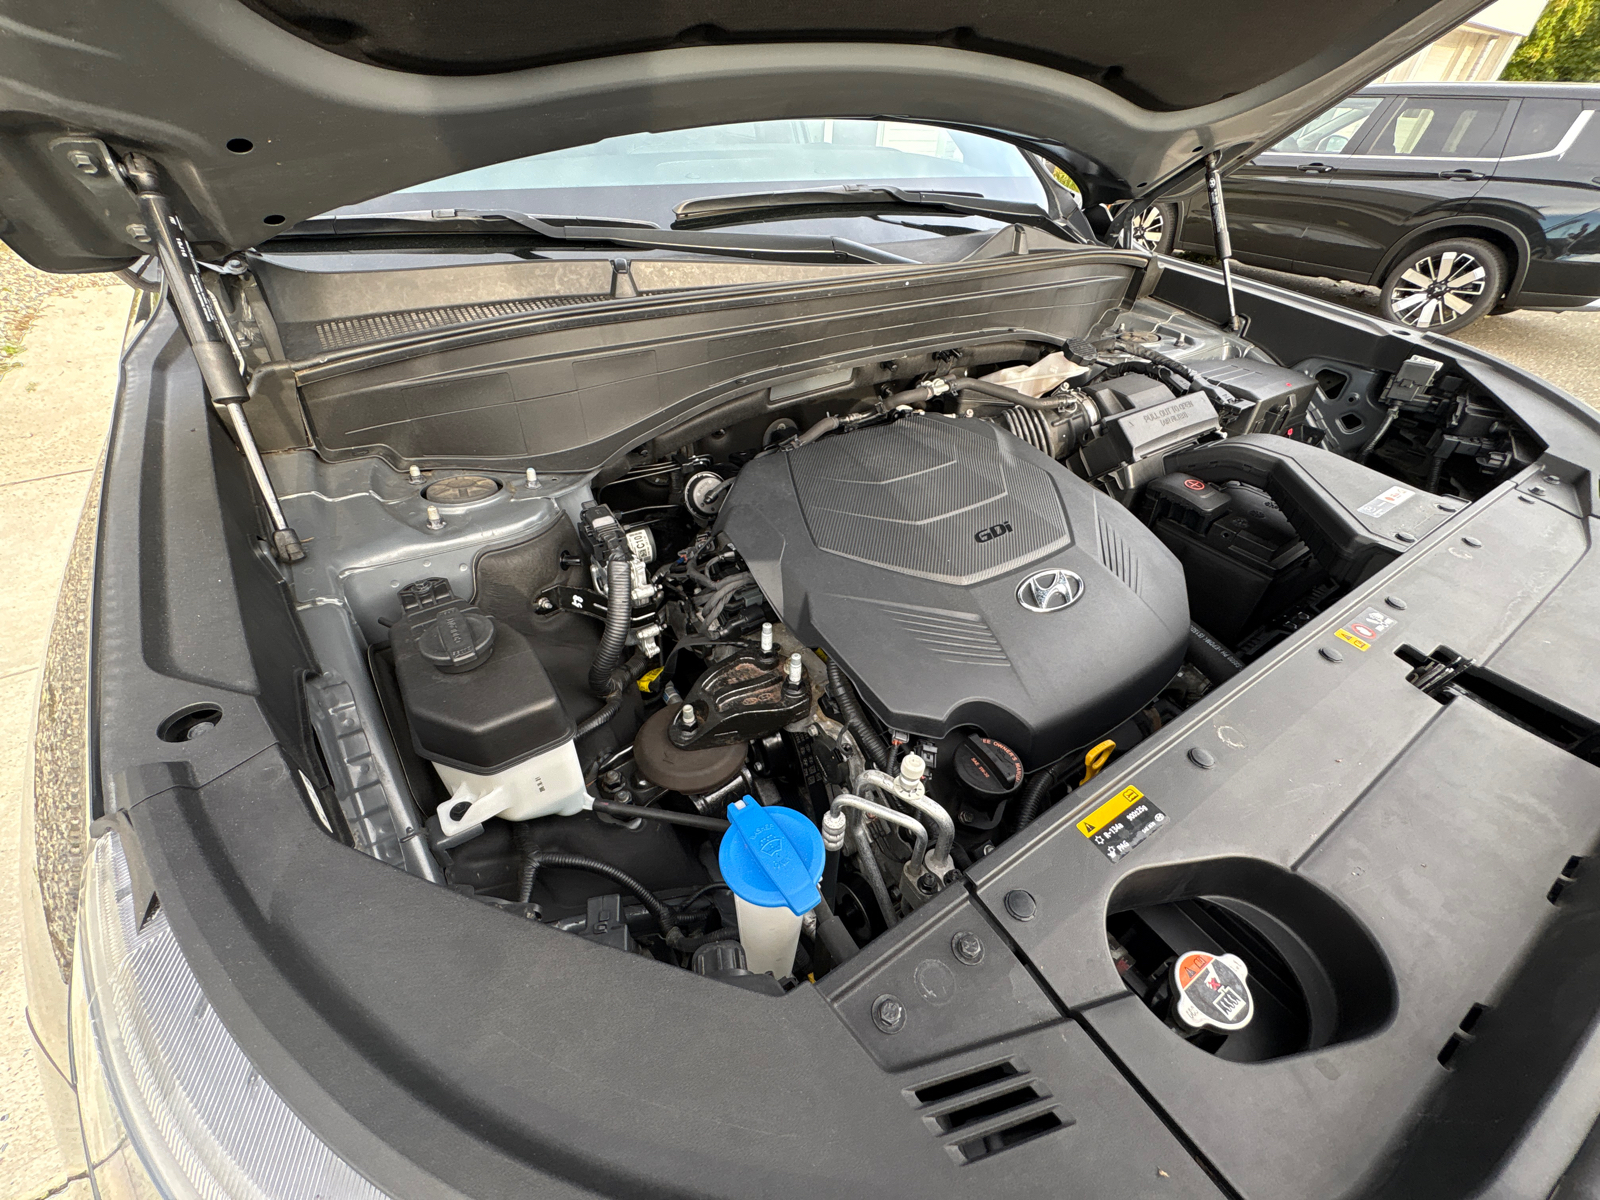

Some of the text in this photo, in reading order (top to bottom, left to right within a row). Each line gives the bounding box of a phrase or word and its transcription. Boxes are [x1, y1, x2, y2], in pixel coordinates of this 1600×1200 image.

[1143, 400, 1194, 423] PULL OUT TO OPEN
[974, 521, 1013, 543] GDi
[634, 535, 645, 549] C10
[1103, 822, 1124, 839] R-134a
[1116, 840, 1130, 852] PAG
